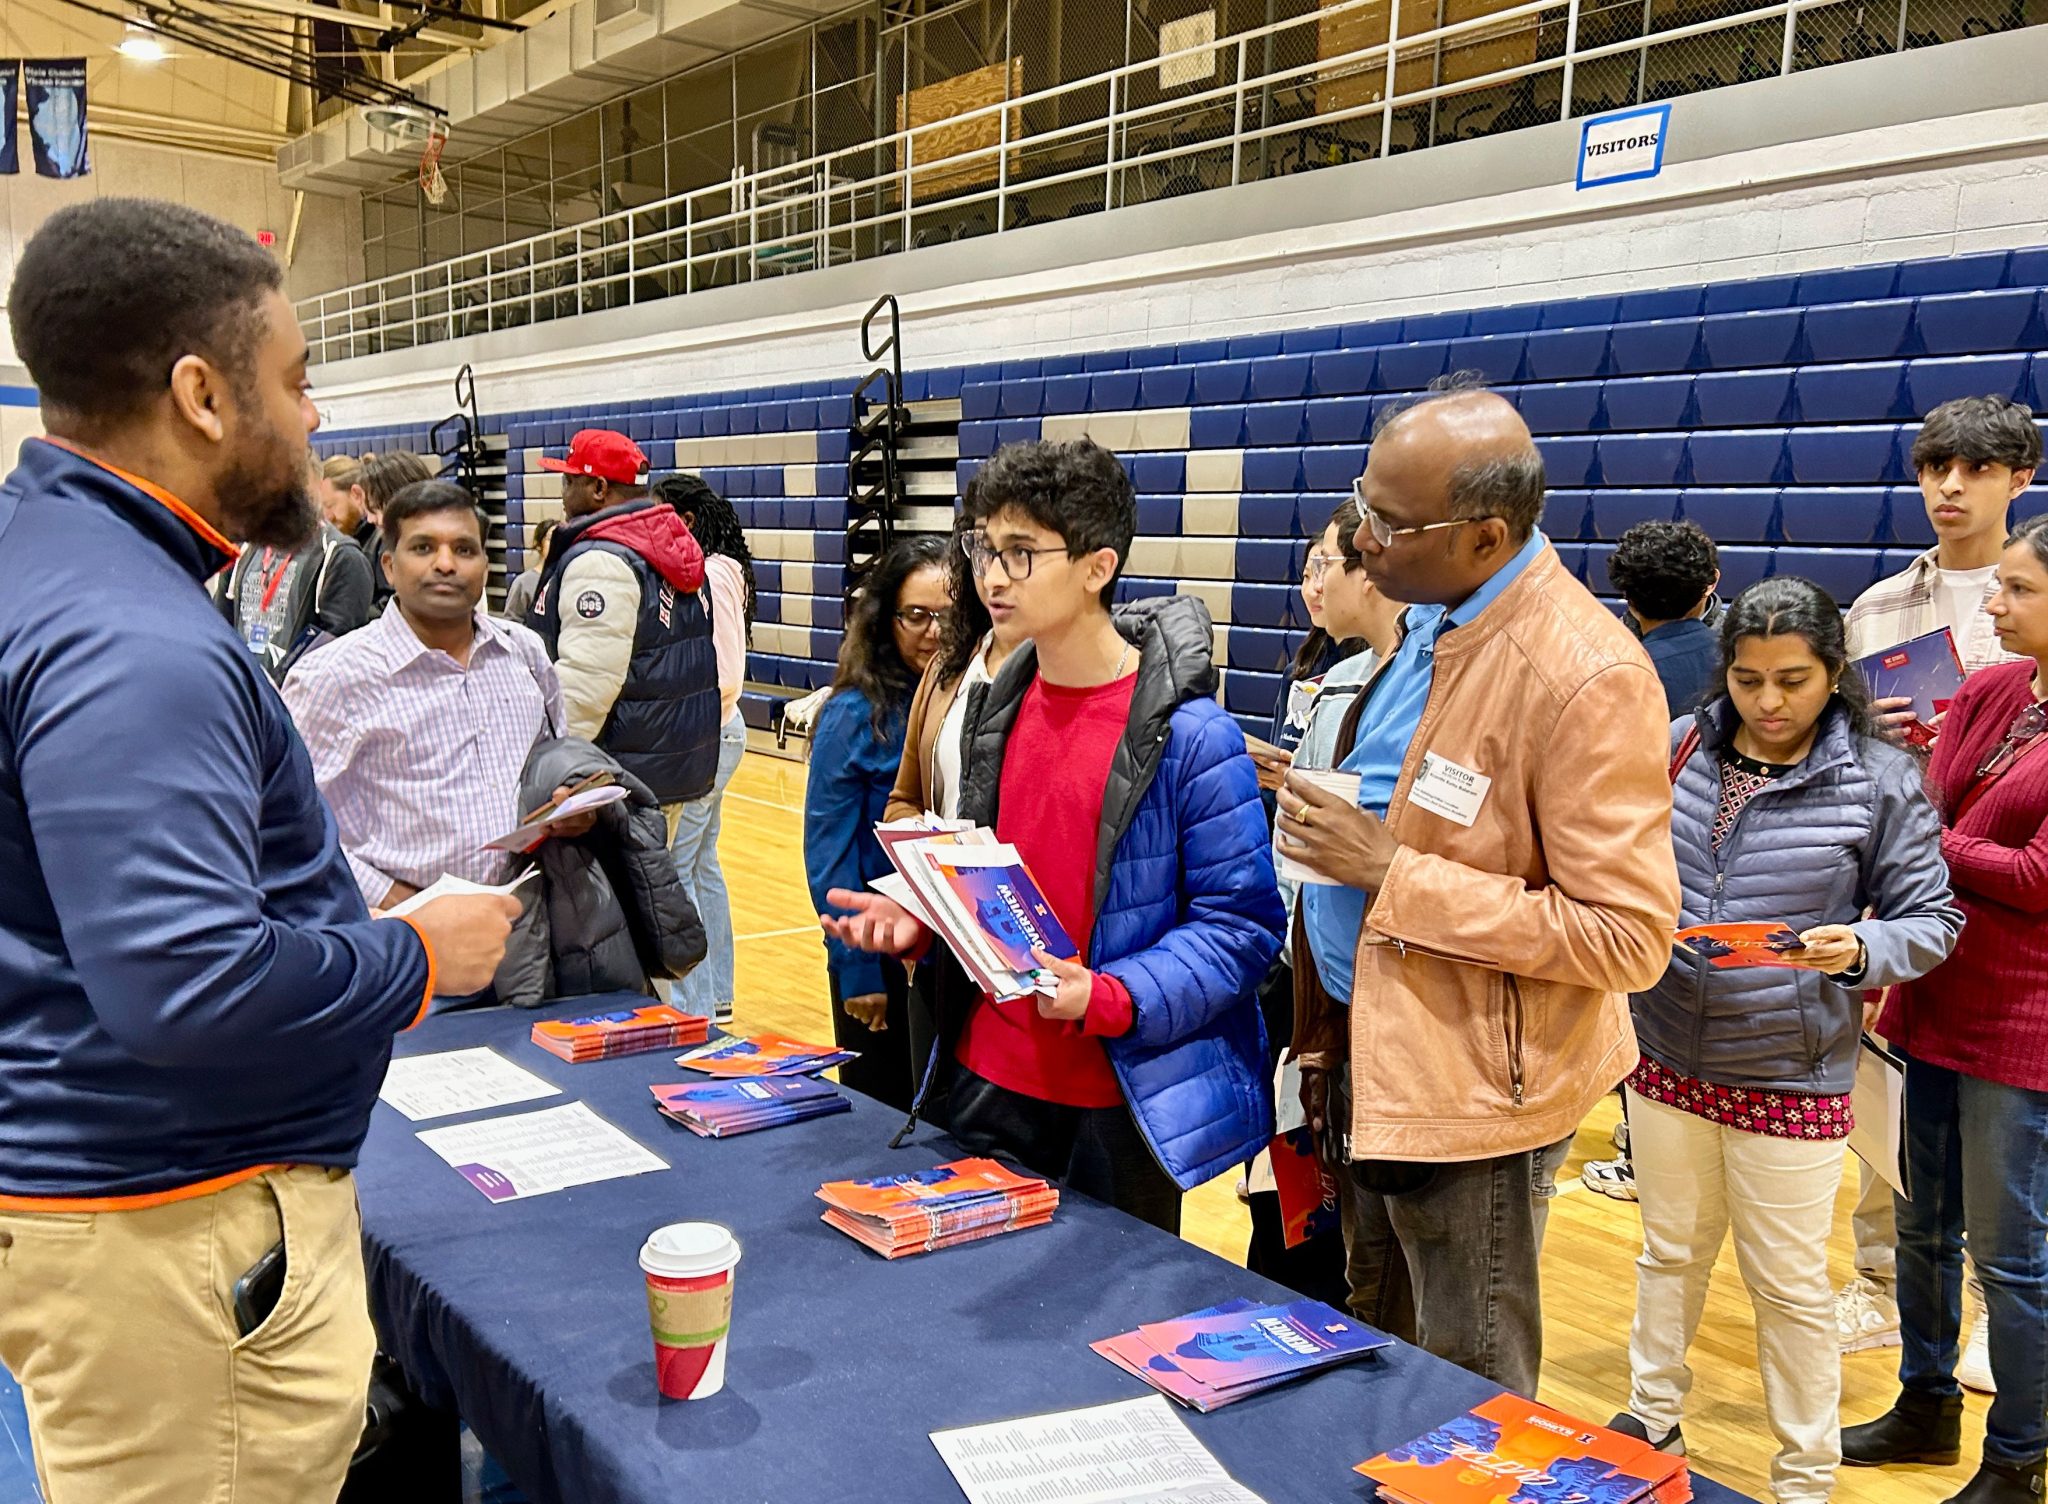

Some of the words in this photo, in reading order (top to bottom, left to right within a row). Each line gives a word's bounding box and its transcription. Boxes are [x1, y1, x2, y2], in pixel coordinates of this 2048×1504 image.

[1587, 133, 1659, 157] VISITORS
[1444, 764, 1475, 783] VISITOR
[997, 884, 1046, 951] OVERVIEW
[1614, 1163, 1635, 1182] N
[1256, 1317, 1322, 1355] OVERVIEW
